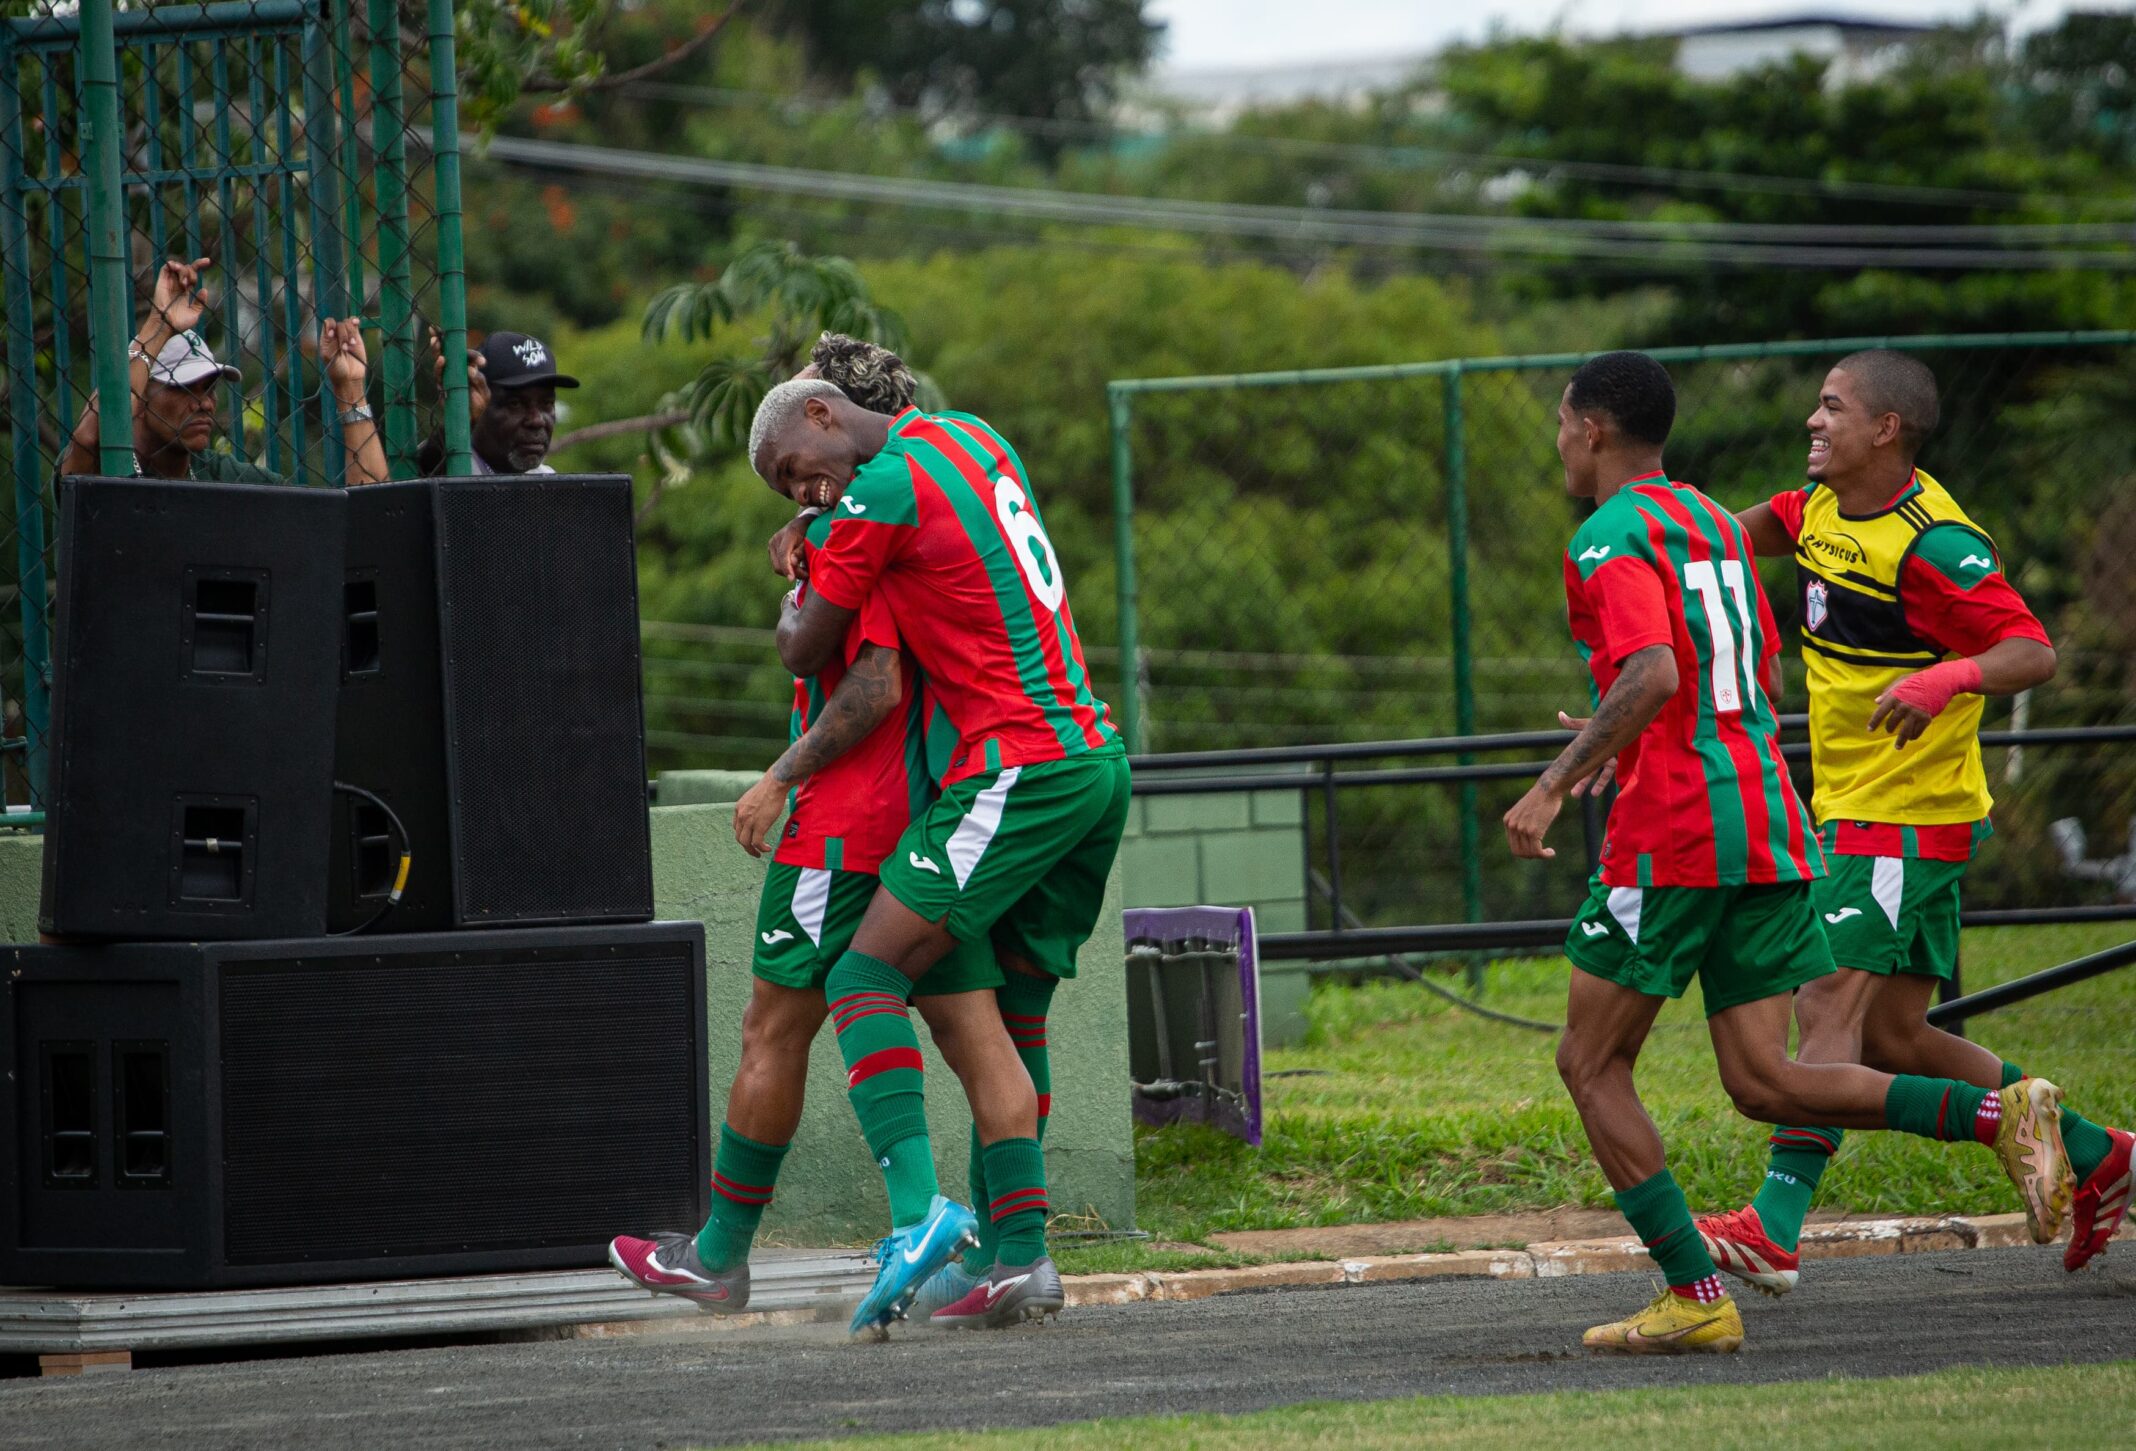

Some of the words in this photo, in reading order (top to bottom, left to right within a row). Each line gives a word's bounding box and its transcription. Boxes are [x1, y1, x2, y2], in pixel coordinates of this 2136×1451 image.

[512, 339, 542, 356] WILD
[995, 476, 1063, 612] 6
[1806, 534, 1858, 563] PHYSICUS
[1684, 560, 1756, 711] 11
